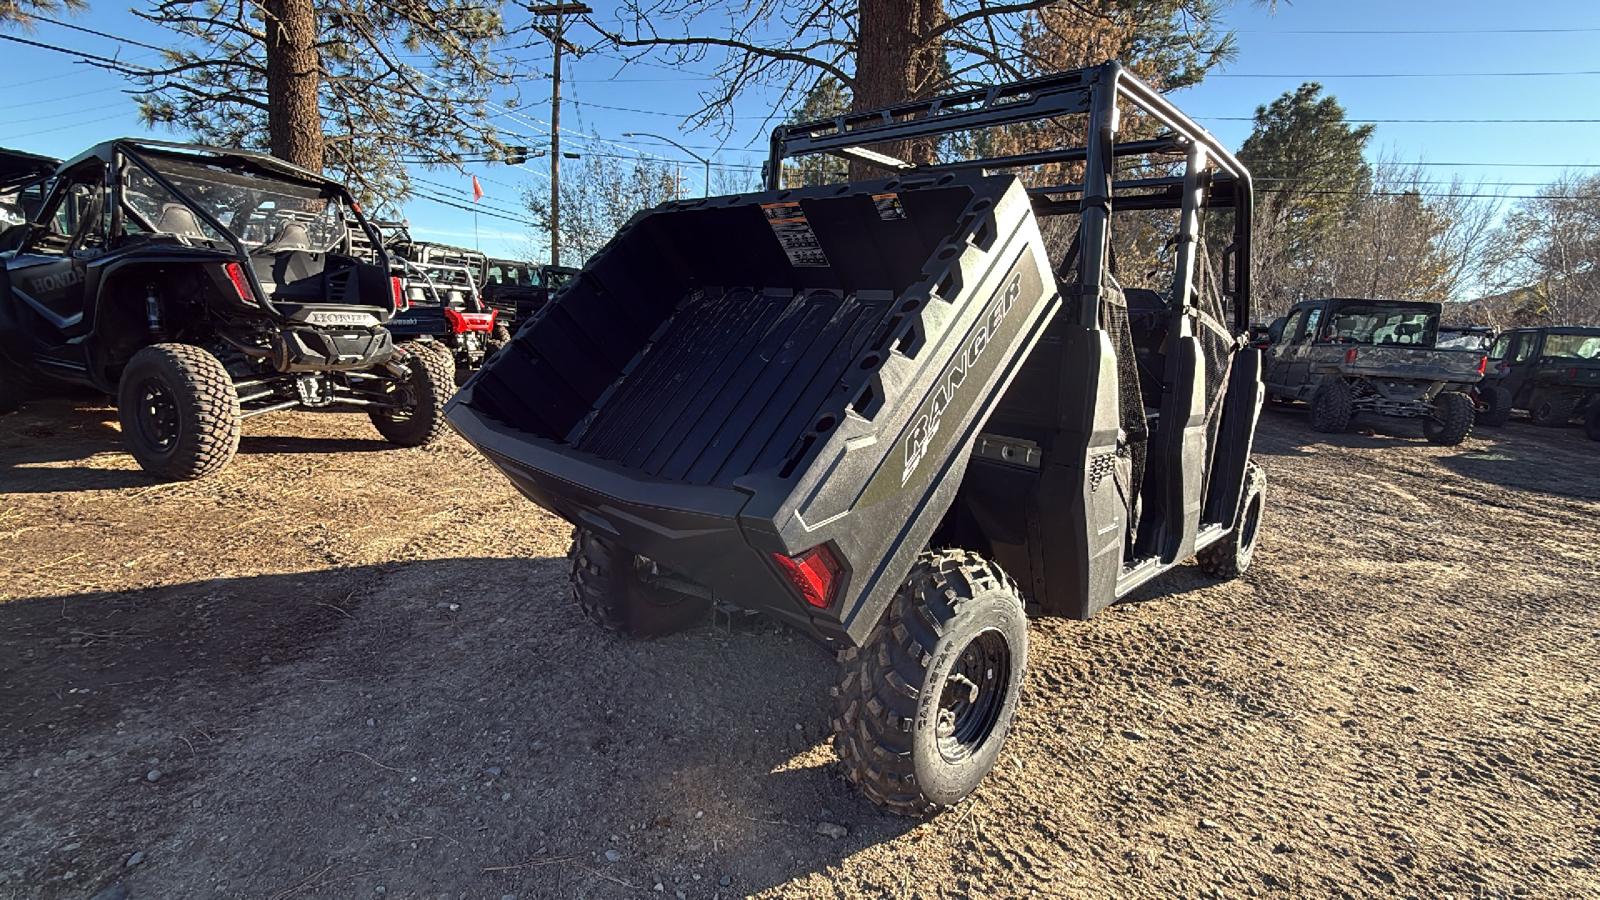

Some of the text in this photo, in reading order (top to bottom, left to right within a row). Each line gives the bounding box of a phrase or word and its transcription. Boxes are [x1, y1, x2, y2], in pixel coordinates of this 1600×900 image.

[31, 266, 85, 293] HONDA
[386, 318, 417, 326] awasaki
[904, 271, 1021, 470] RANGER
